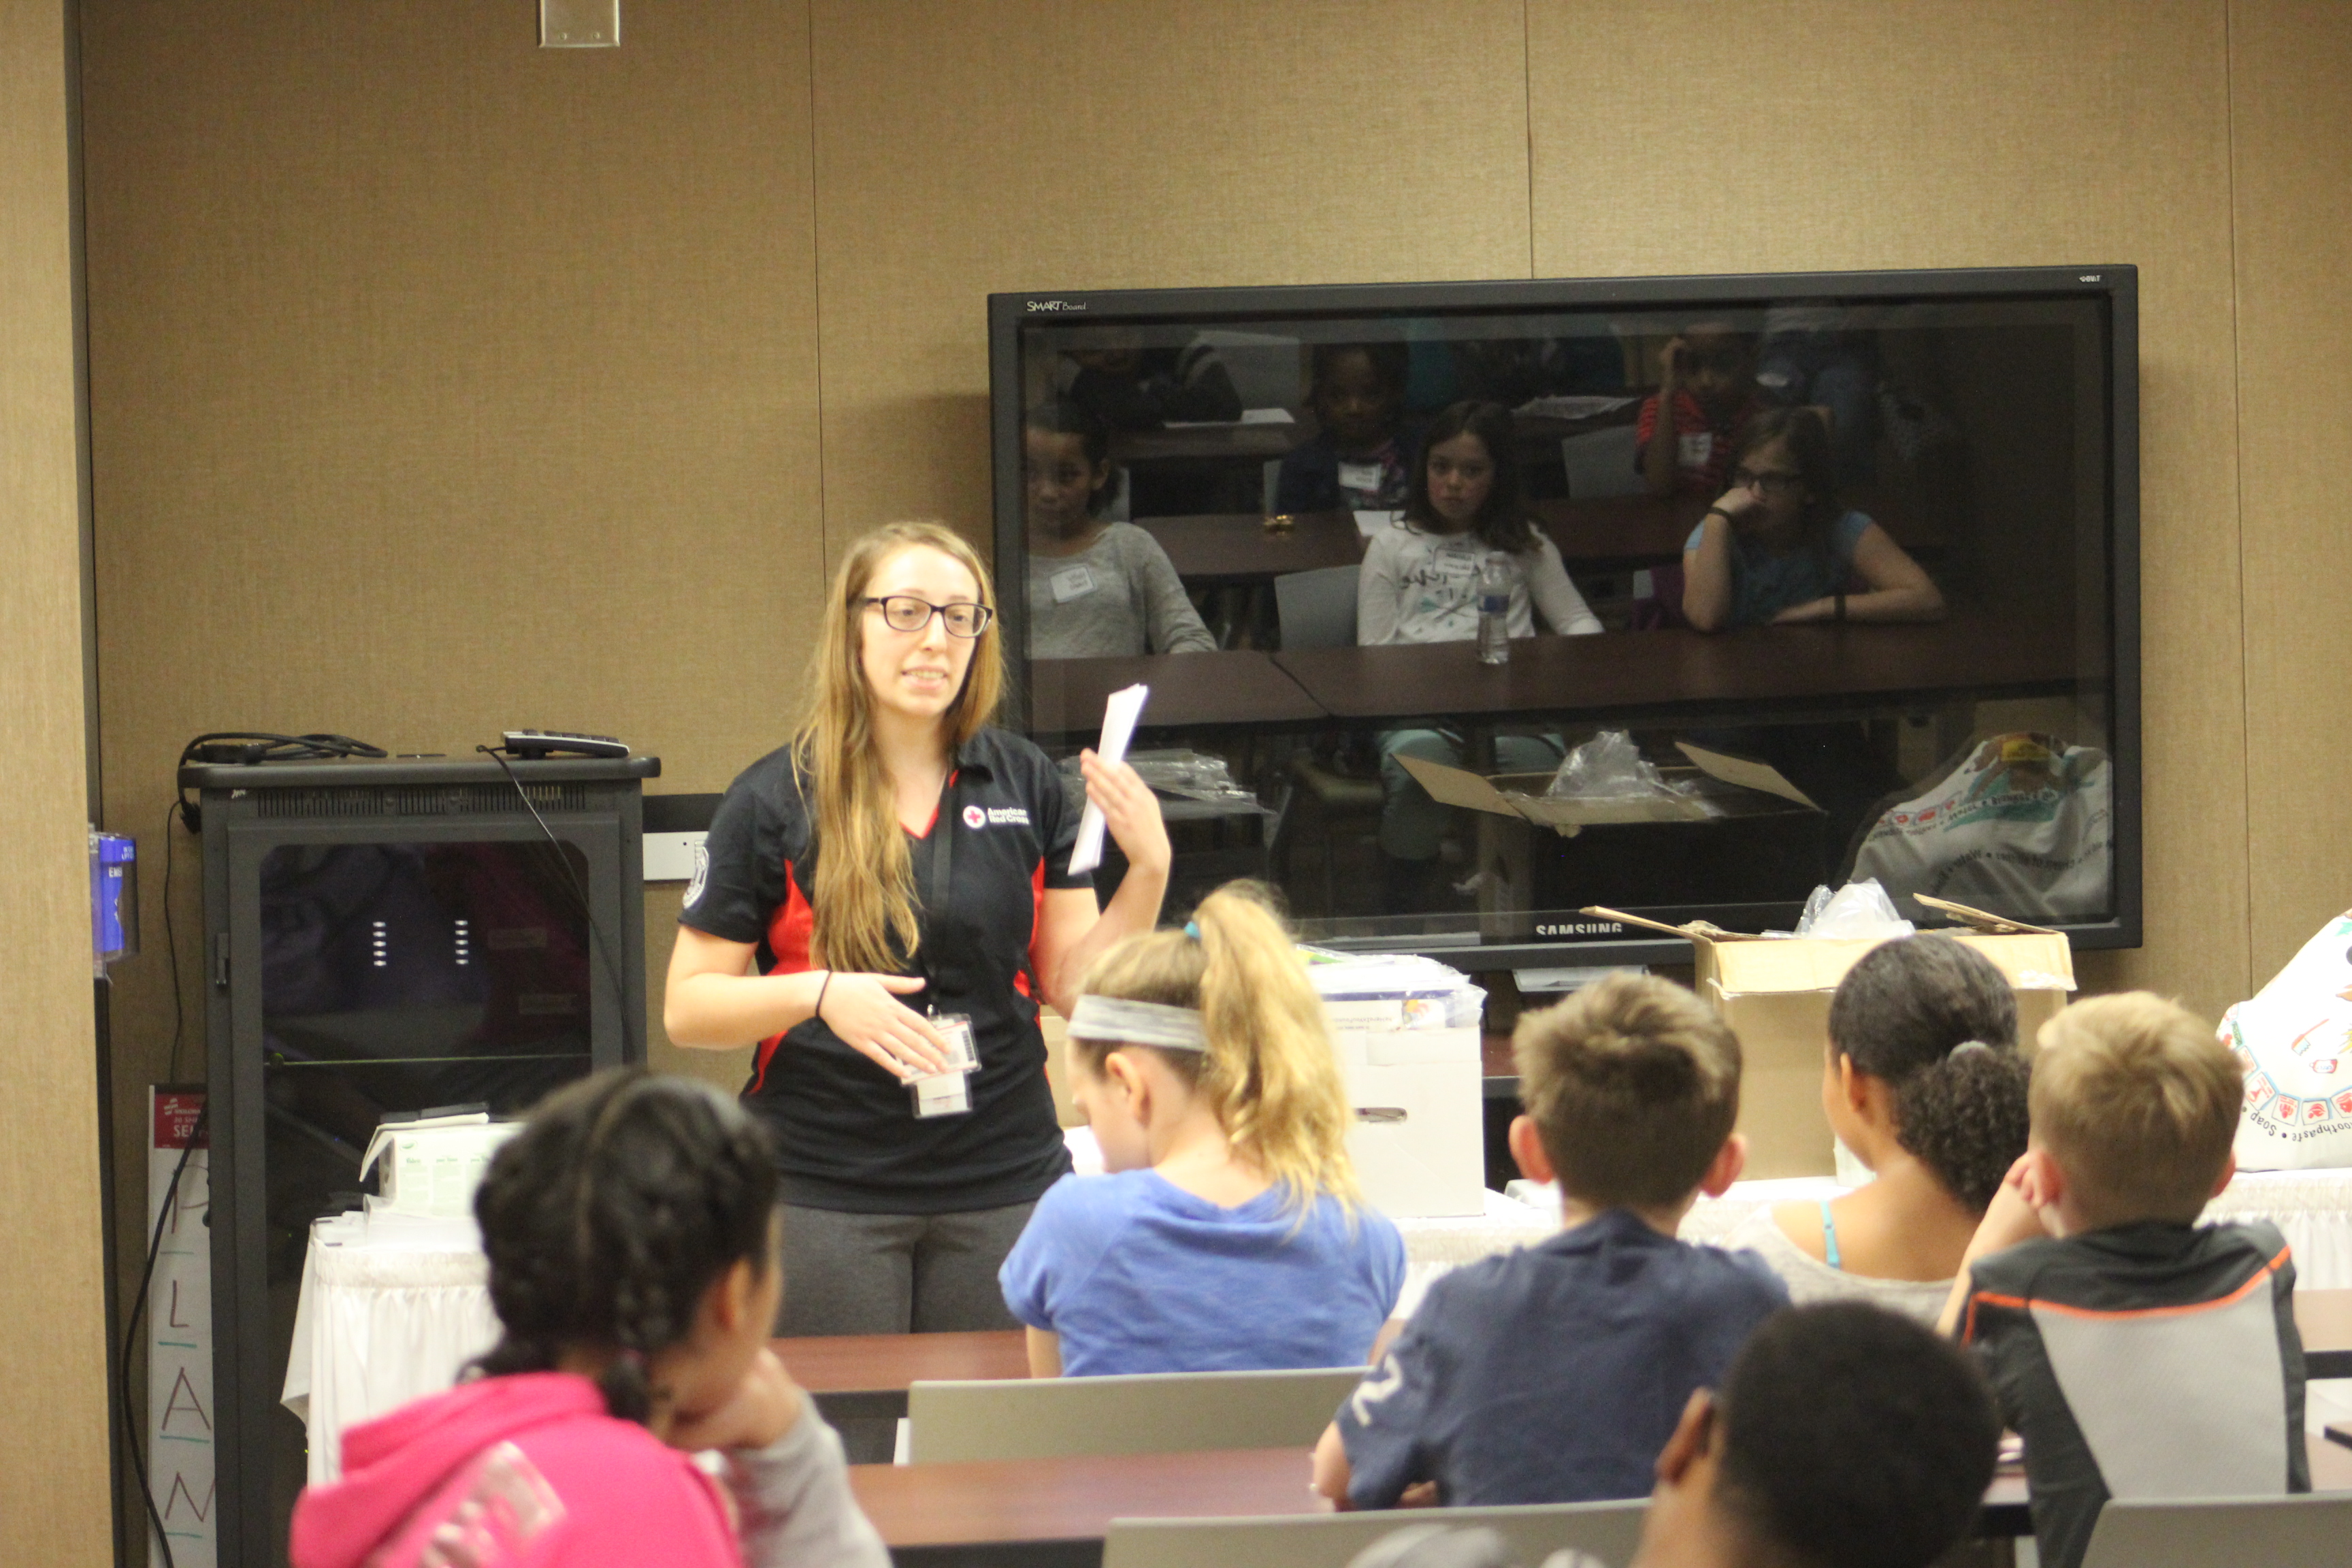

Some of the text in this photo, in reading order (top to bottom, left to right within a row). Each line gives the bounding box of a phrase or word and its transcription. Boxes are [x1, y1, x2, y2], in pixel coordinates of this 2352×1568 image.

[1026, 301, 1087, 312] SMART Board
[987, 807, 1027, 816] American
[989, 815, 1030, 825] Red Cross
[1535, 922, 1622, 935] SAMSUNG
[2250, 1111, 2352, 1143] oothpaste Soap
